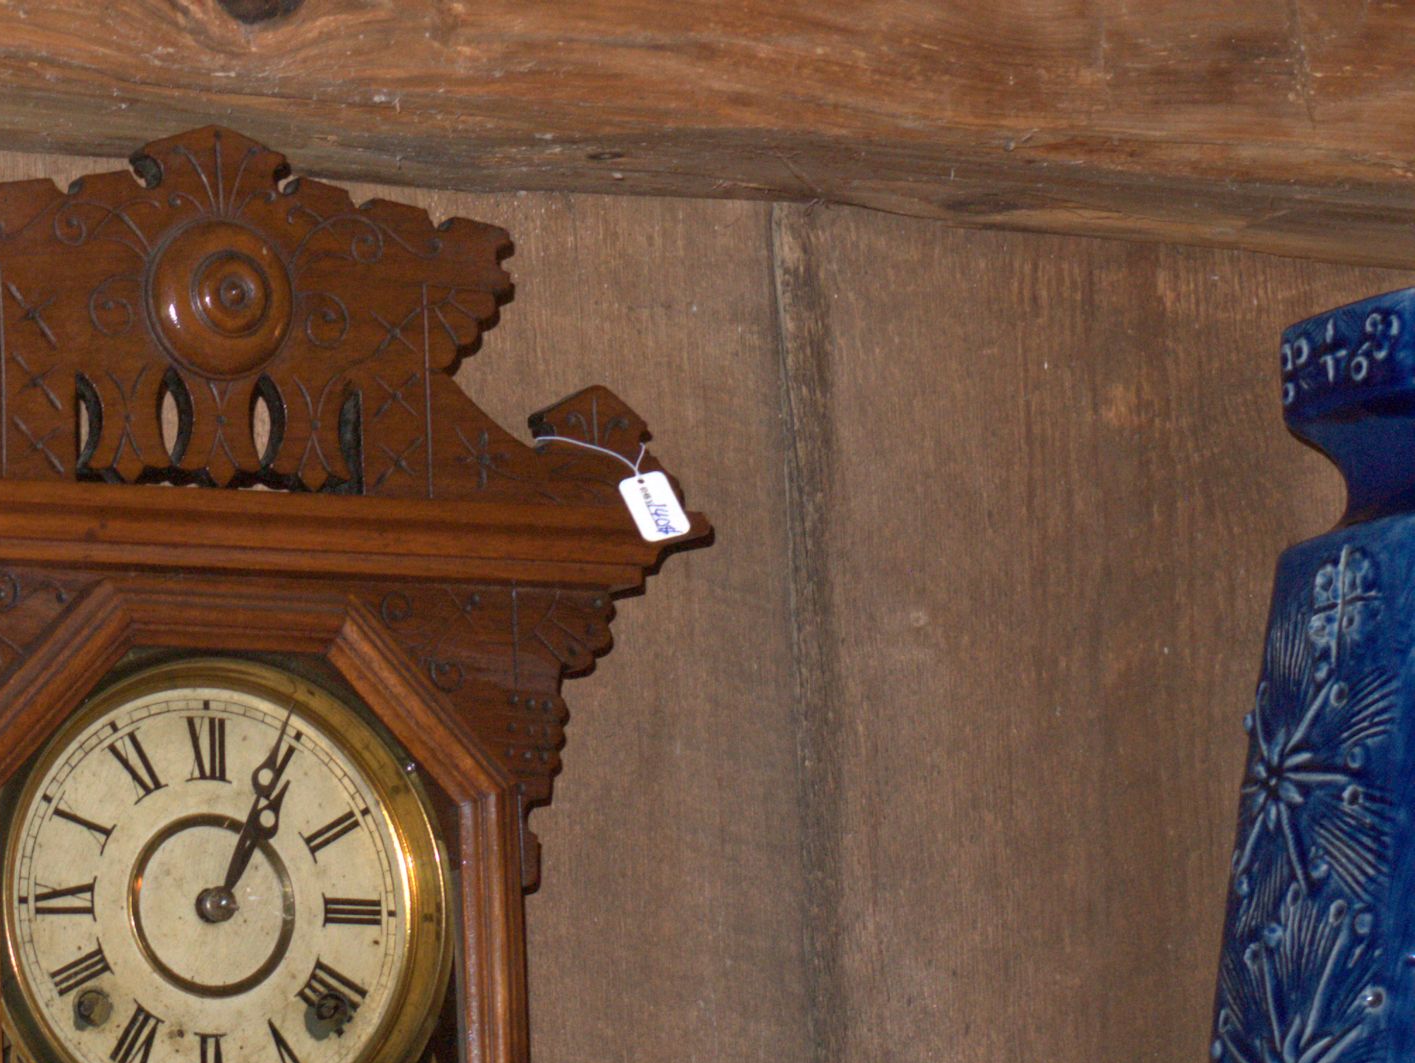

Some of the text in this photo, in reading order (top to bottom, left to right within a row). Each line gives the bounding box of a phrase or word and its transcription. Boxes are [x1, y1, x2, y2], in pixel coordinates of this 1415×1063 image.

[102, 727, 169, 805] XI
[180, 716, 232, 783] XII
[50, 790, 117, 856] X
[298, 802, 368, 864] II
[34, 876, 97, 922] IX
[323, 892, 382, 927] III
